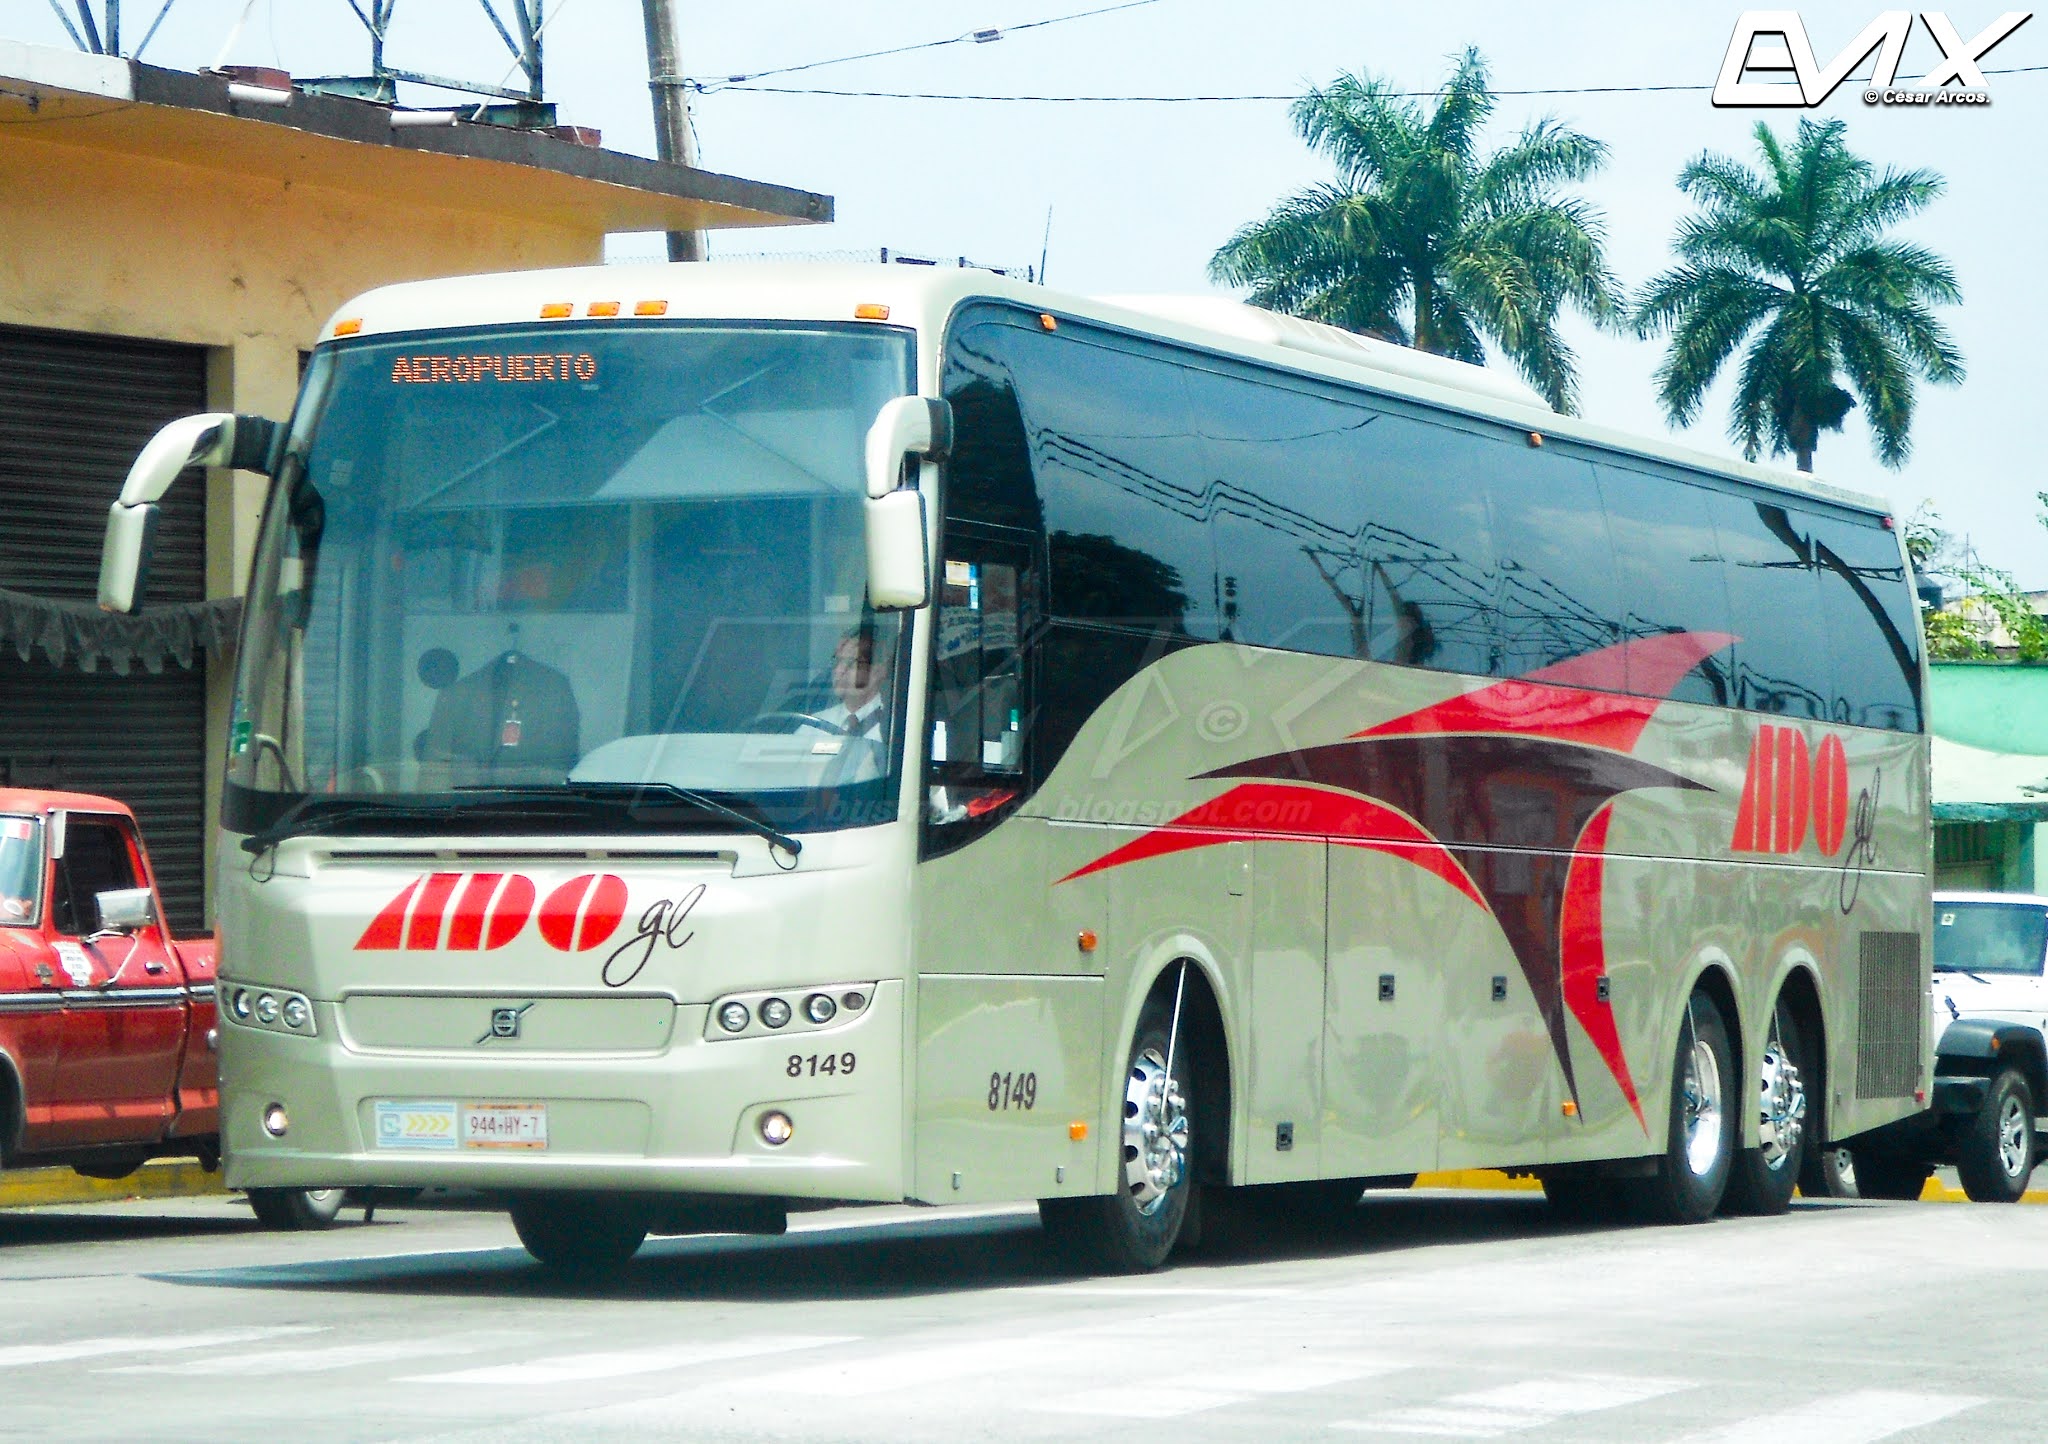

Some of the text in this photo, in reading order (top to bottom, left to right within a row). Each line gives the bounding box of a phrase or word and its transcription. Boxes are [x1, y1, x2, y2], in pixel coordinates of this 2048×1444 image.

[391, 354, 596, 383] AEROPUERTO
[1730, 724, 1849, 857] ADO
[353, 873, 628, 953] ADO
[786, 1052, 856, 1078] 8149
[988, 1071, 1037, 1112] 8149
